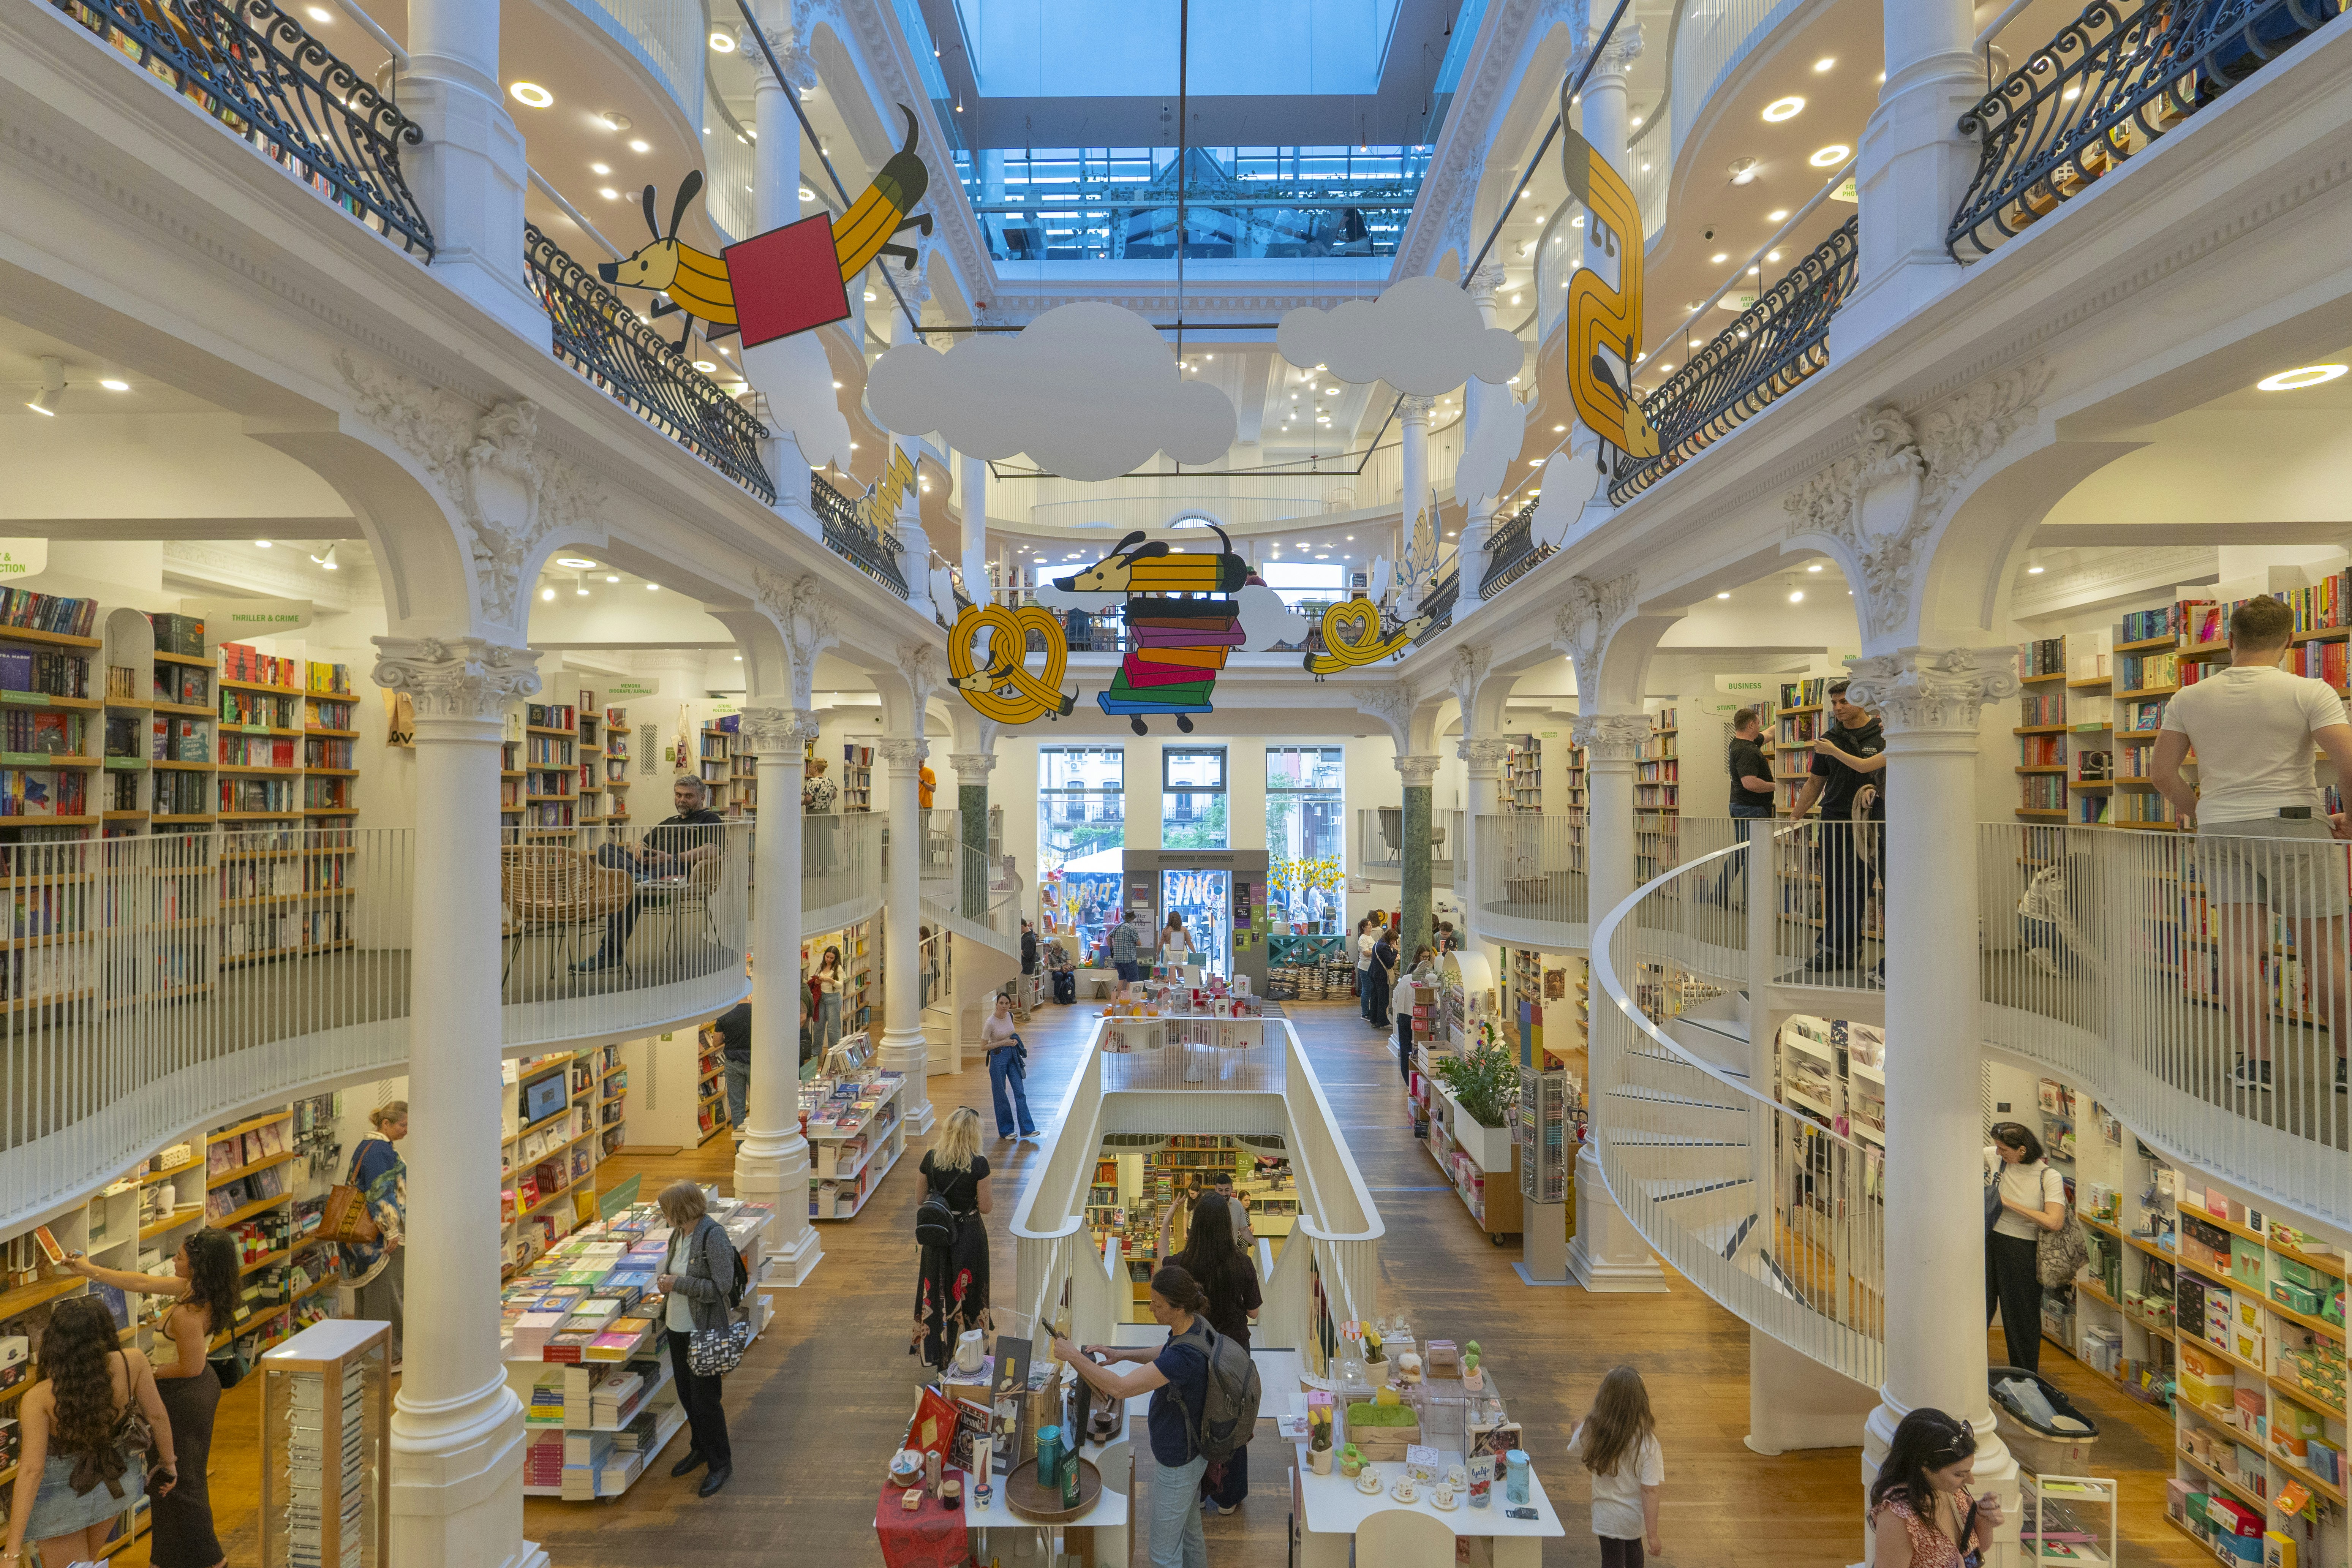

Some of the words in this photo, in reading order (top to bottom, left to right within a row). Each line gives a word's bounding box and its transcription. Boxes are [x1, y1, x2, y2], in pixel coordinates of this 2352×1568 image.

[4, 553, 11, 561] &
[961, 1413, 981, 1430] Chesnok
[1063, 1455, 1076, 1470] FOREST
[1065, 1460, 1077, 1473] FEAST
[1472, 1466, 1490, 1478] lyolife
